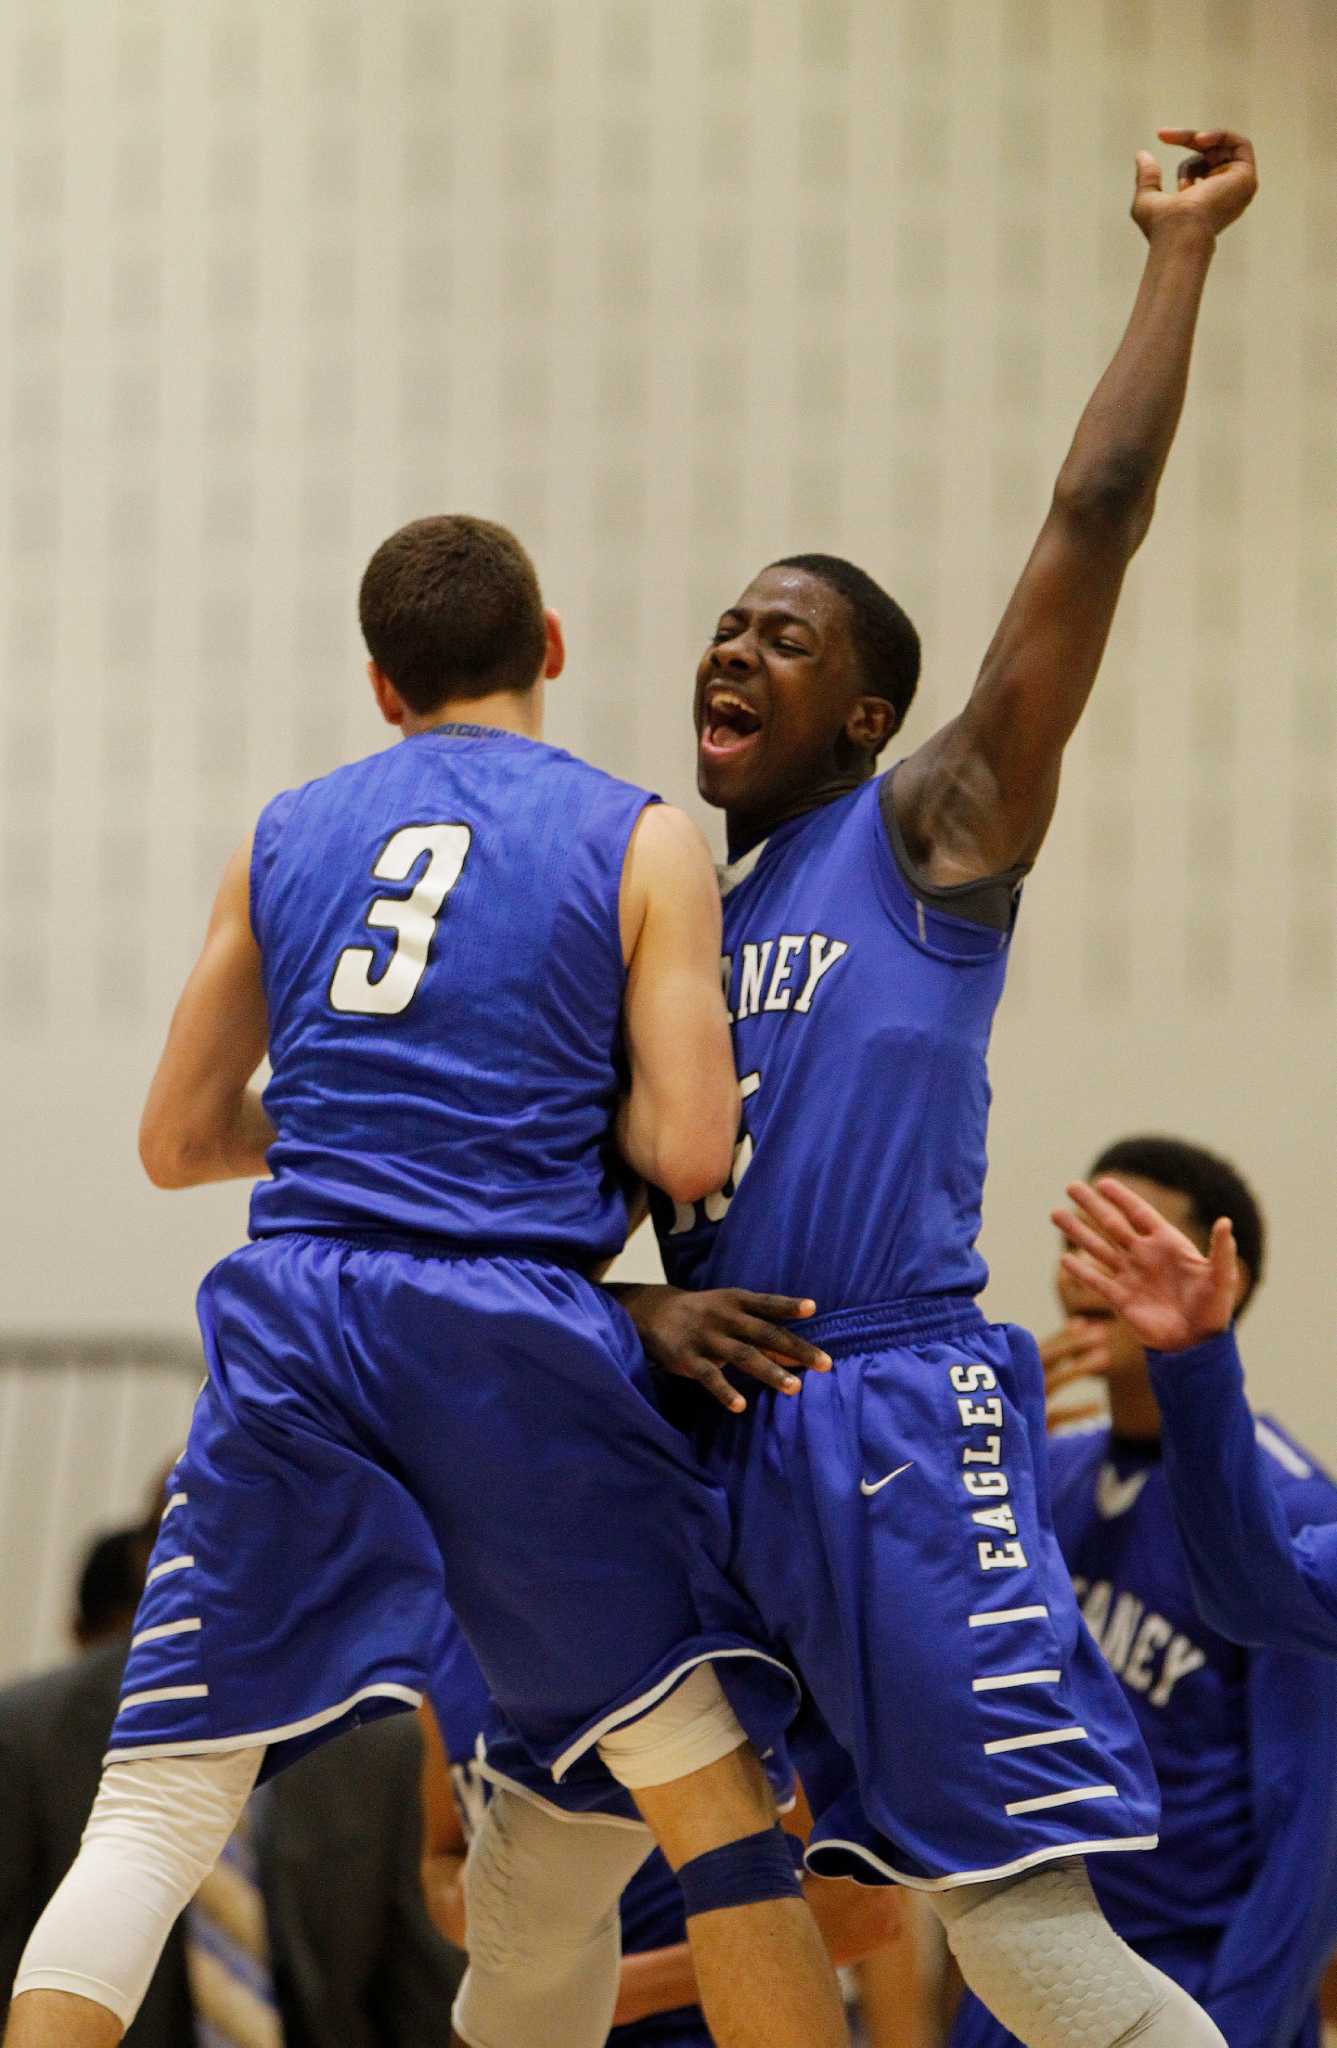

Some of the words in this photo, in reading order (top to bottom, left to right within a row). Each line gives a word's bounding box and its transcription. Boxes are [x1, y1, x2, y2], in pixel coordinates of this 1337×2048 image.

[328, 823, 473, 1015] 3
[720, 932, 849, 1025] NEY
[949, 1363, 1029, 1572] EAGLES
[1071, 1576, 1206, 1707] ANEY
